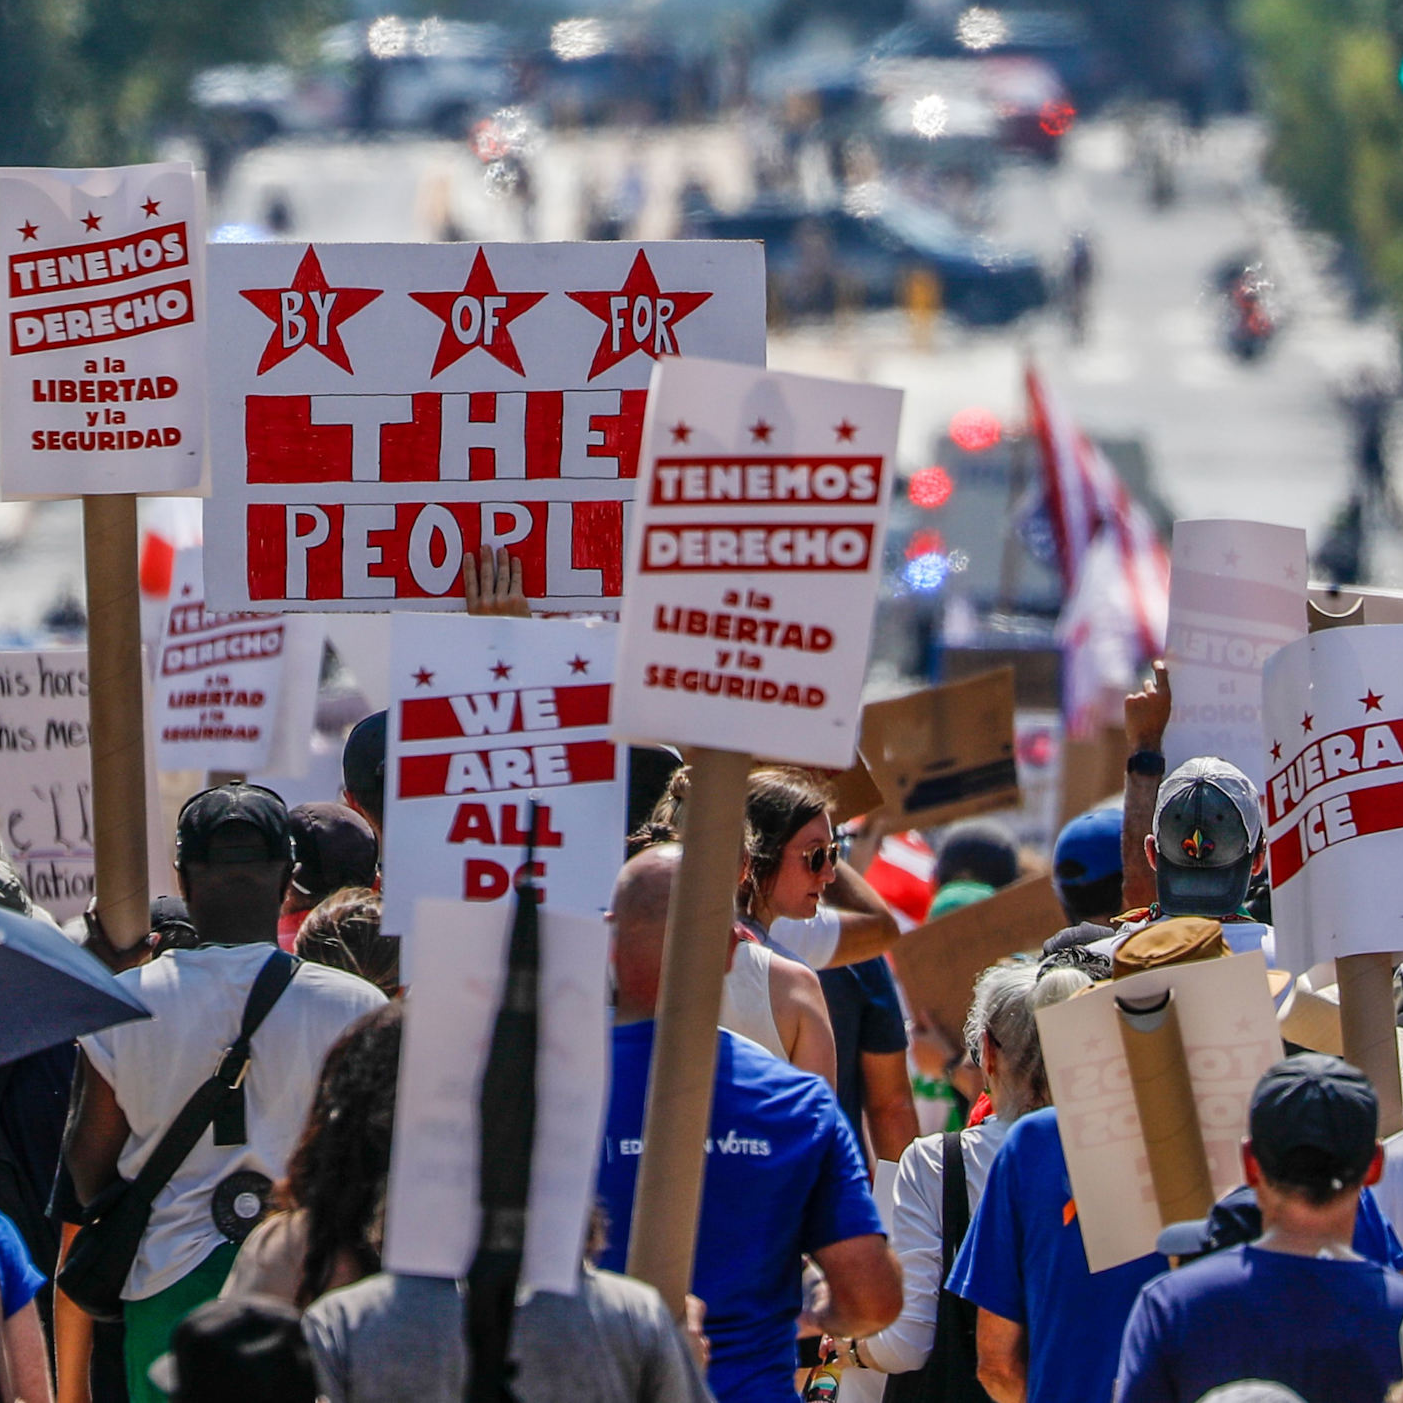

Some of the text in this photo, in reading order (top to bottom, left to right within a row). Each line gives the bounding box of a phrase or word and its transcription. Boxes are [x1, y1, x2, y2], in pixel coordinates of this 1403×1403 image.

[13, 232, 184, 290] TENEMOS
[15, 289, 188, 347] DERECHO
[280, 290, 675, 354] BY OF FOR
[84, 357, 125, 374] a la
[32, 376, 178, 403] LIBERTAD
[32, 427, 181, 451] SEGURIDAD
[85, 408, 126, 427] y la
[310, 389, 621, 482] THE
[657, 465, 877, 499] TENEMOS
[285, 500, 635, 599] PEOPL
[648, 530, 866, 567] DERECHO
[722, 588, 772, 611] a la
[655, 606, 834, 653] LIBERTAD
[716, 649, 763, 671] y la
[644, 665, 827, 709] SEGURIDAD
[449, 688, 560, 736] WE
[444, 745, 571, 794] ARE
[447, 804, 563, 847] ALL
[1299, 794, 1357, 864] ICE
[717, 1129, 772, 1156] VOTES
